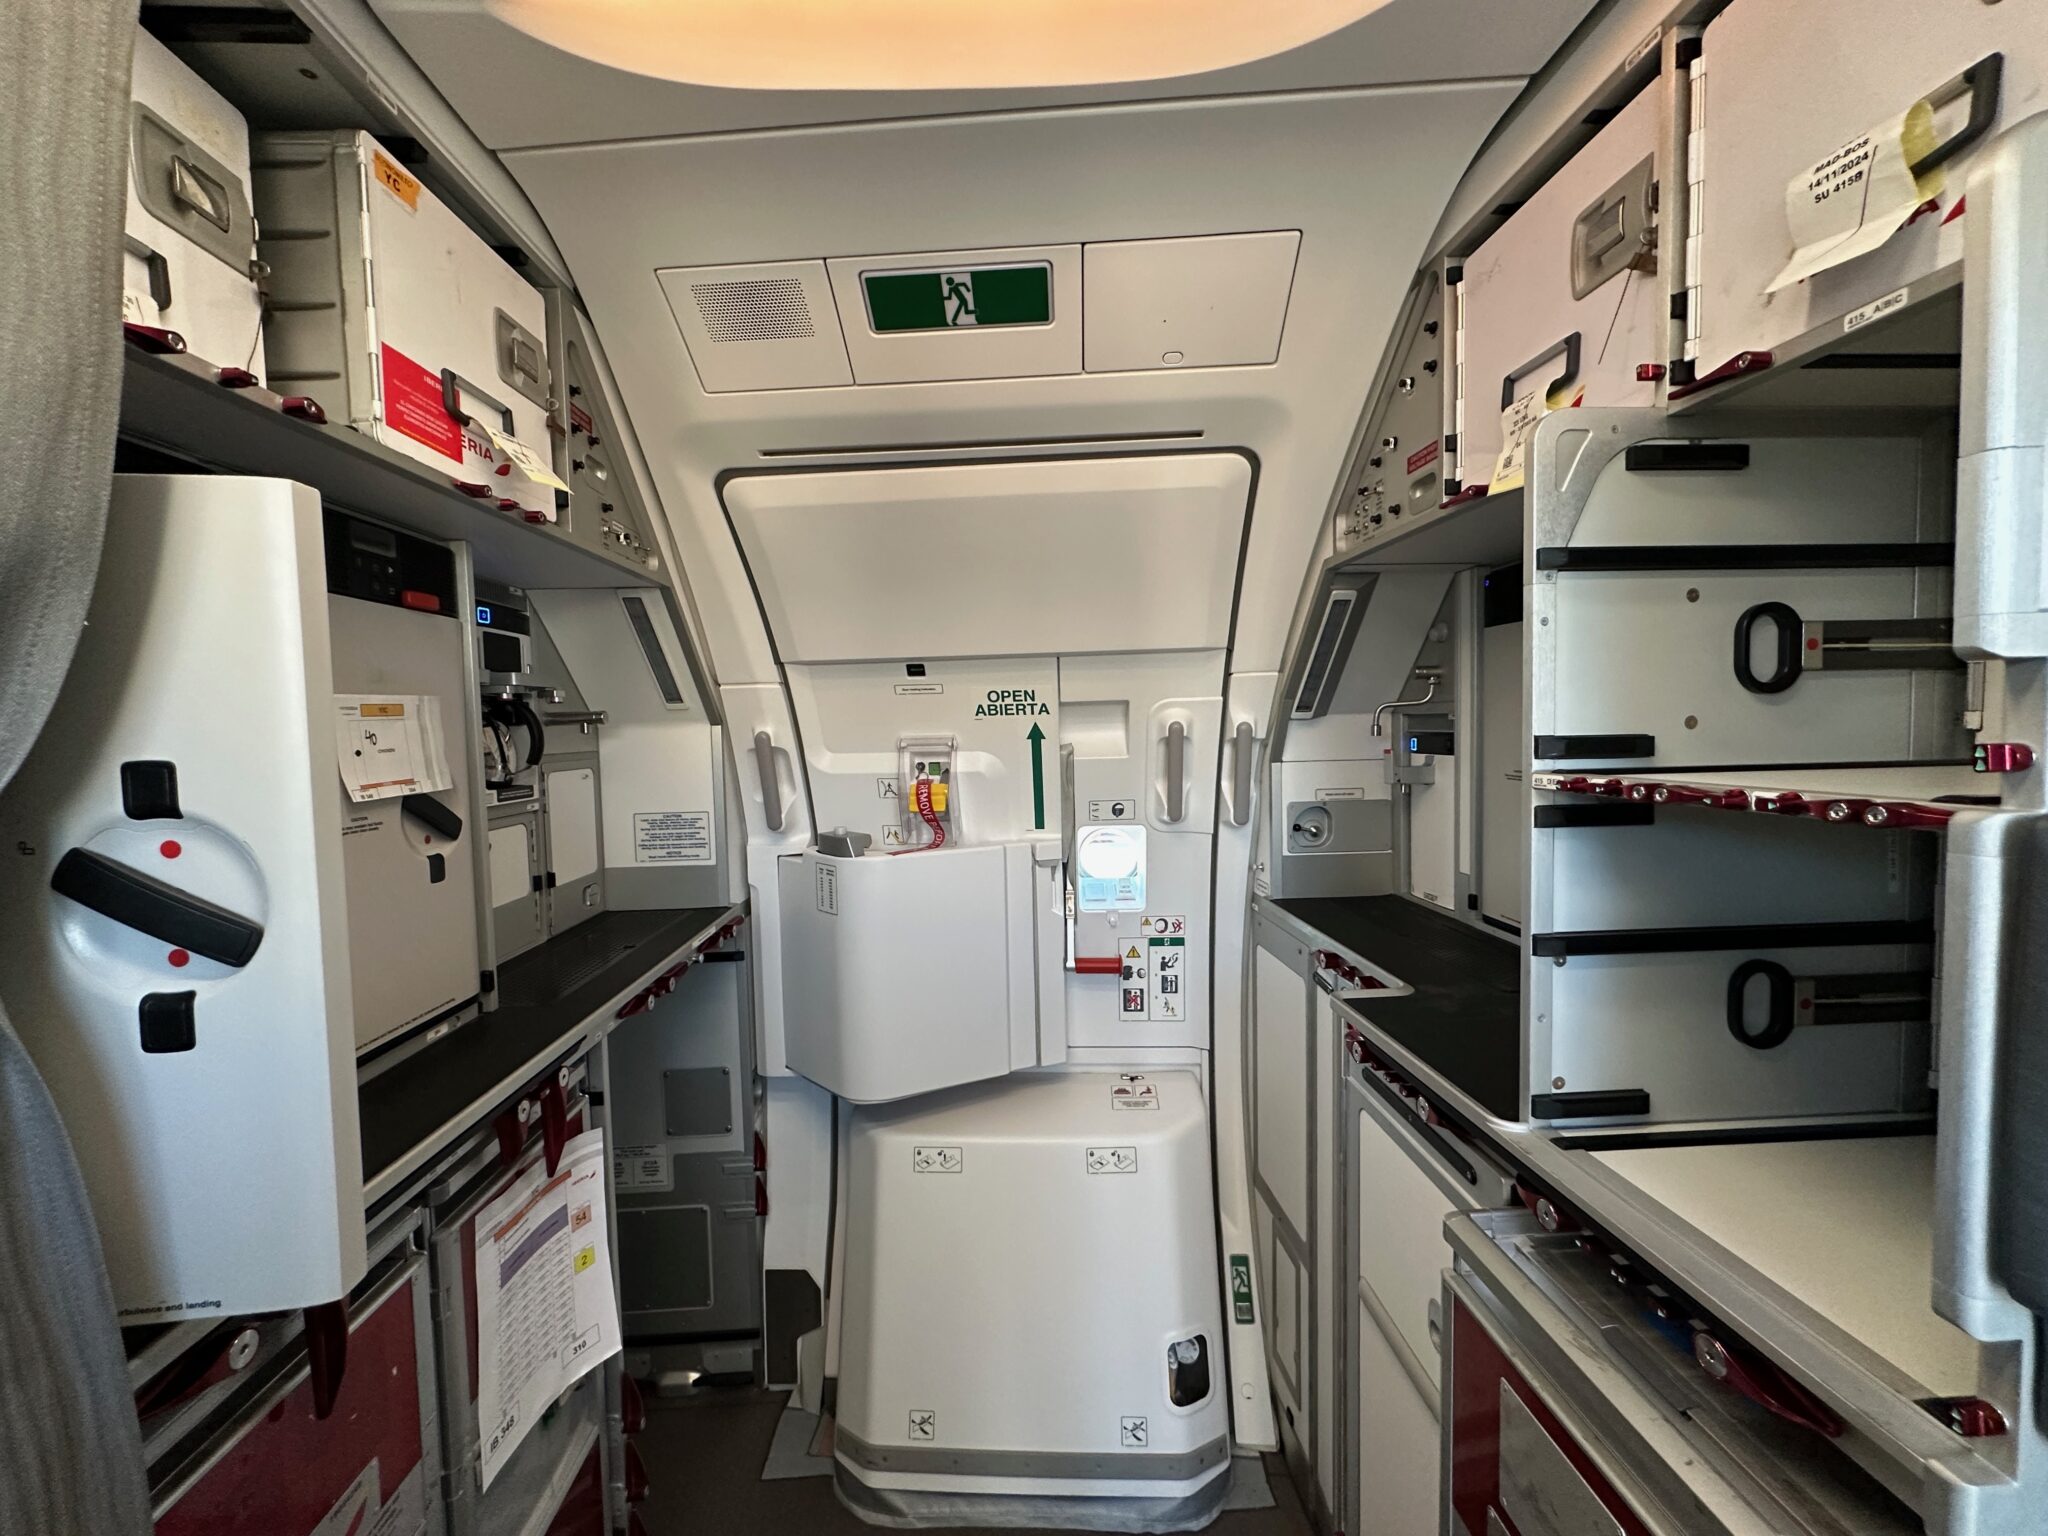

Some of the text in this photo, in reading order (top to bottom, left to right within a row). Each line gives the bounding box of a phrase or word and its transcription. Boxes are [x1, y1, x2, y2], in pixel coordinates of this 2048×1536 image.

[1813, 137, 1870, 176] MAD-BOS
[1808, 151, 1870, 191] 14/11/2024
[1814, 188, 1830, 204] SU
[423, 375, 443, 391] IBERI
[461, 433, 494, 463] ERIA
[987, 689, 1036, 703] OPEN
[975, 703, 1050, 717] ABIERTA
[918, 784, 934, 820] REMOVE
[575, 1211, 587, 1225] 54
[581, 1255, 588, 1266] 2
[119, 1300, 222, 1316] rbulence and landing
[573, 1340, 587, 1355] 310
[490, 1437, 499, 1452] IB
